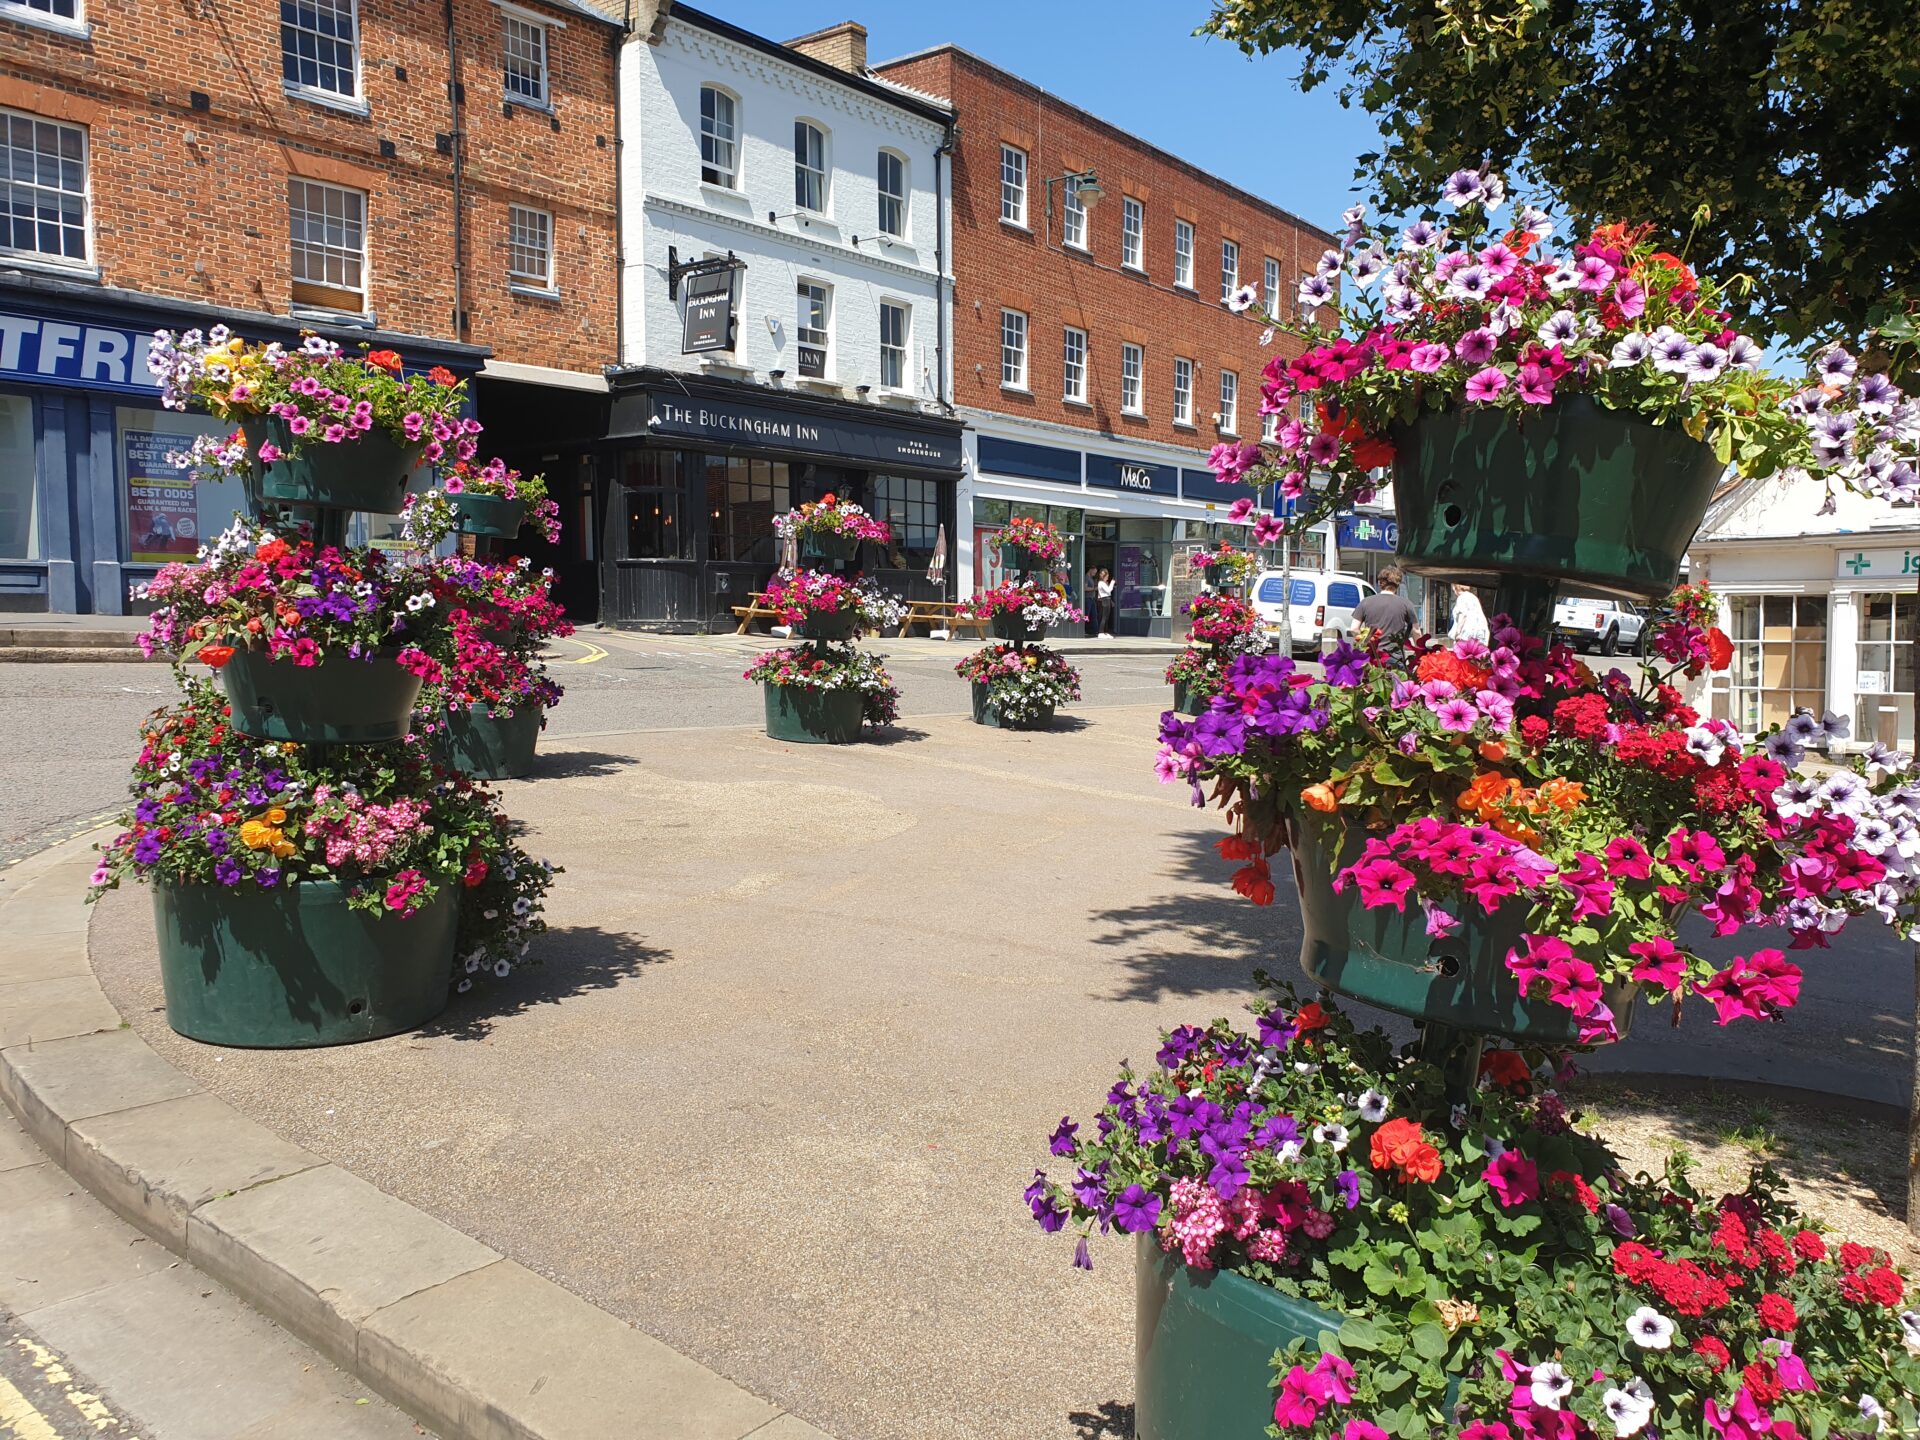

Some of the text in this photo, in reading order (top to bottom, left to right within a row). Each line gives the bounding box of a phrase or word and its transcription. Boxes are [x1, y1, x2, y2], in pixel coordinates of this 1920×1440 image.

[699, 307, 716, 320] INN
[800, 351, 820, 365] INN
[662, 403, 818, 441] THE BUCKINGHAM INN
[179, 438, 192, 446] DAY
[910, 440, 922, 448] PUB
[128, 449, 157, 460] BEST
[897, 446, 941, 458] SMOKEHOUSE
[131, 487, 194, 499] BEST ODDS
[137, 498, 179, 506] GUARANTEED
